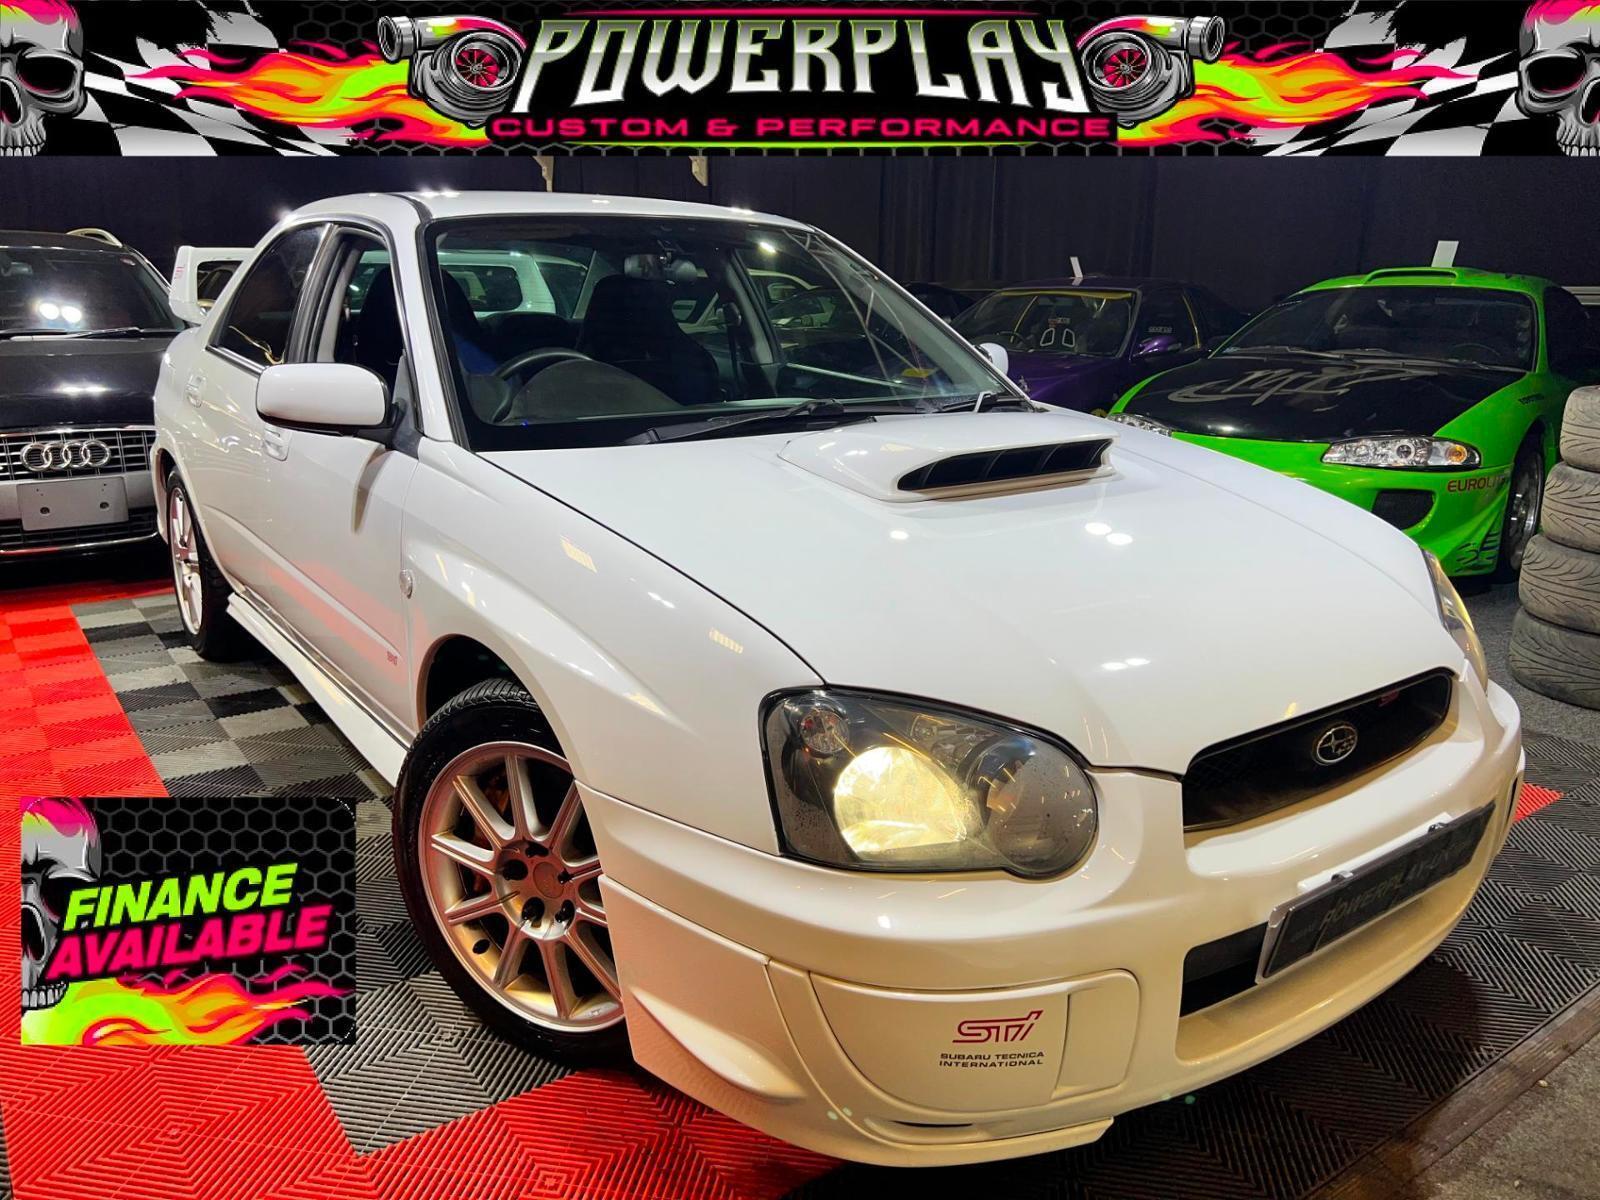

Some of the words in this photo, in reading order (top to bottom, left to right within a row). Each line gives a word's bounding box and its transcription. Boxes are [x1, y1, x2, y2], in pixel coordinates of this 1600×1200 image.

[940, 1052, 991, 1061] SUBARU
[995, 1051, 1045, 1060] TECNICA
[939, 1059, 1044, 1068] INTERNATIONAL
